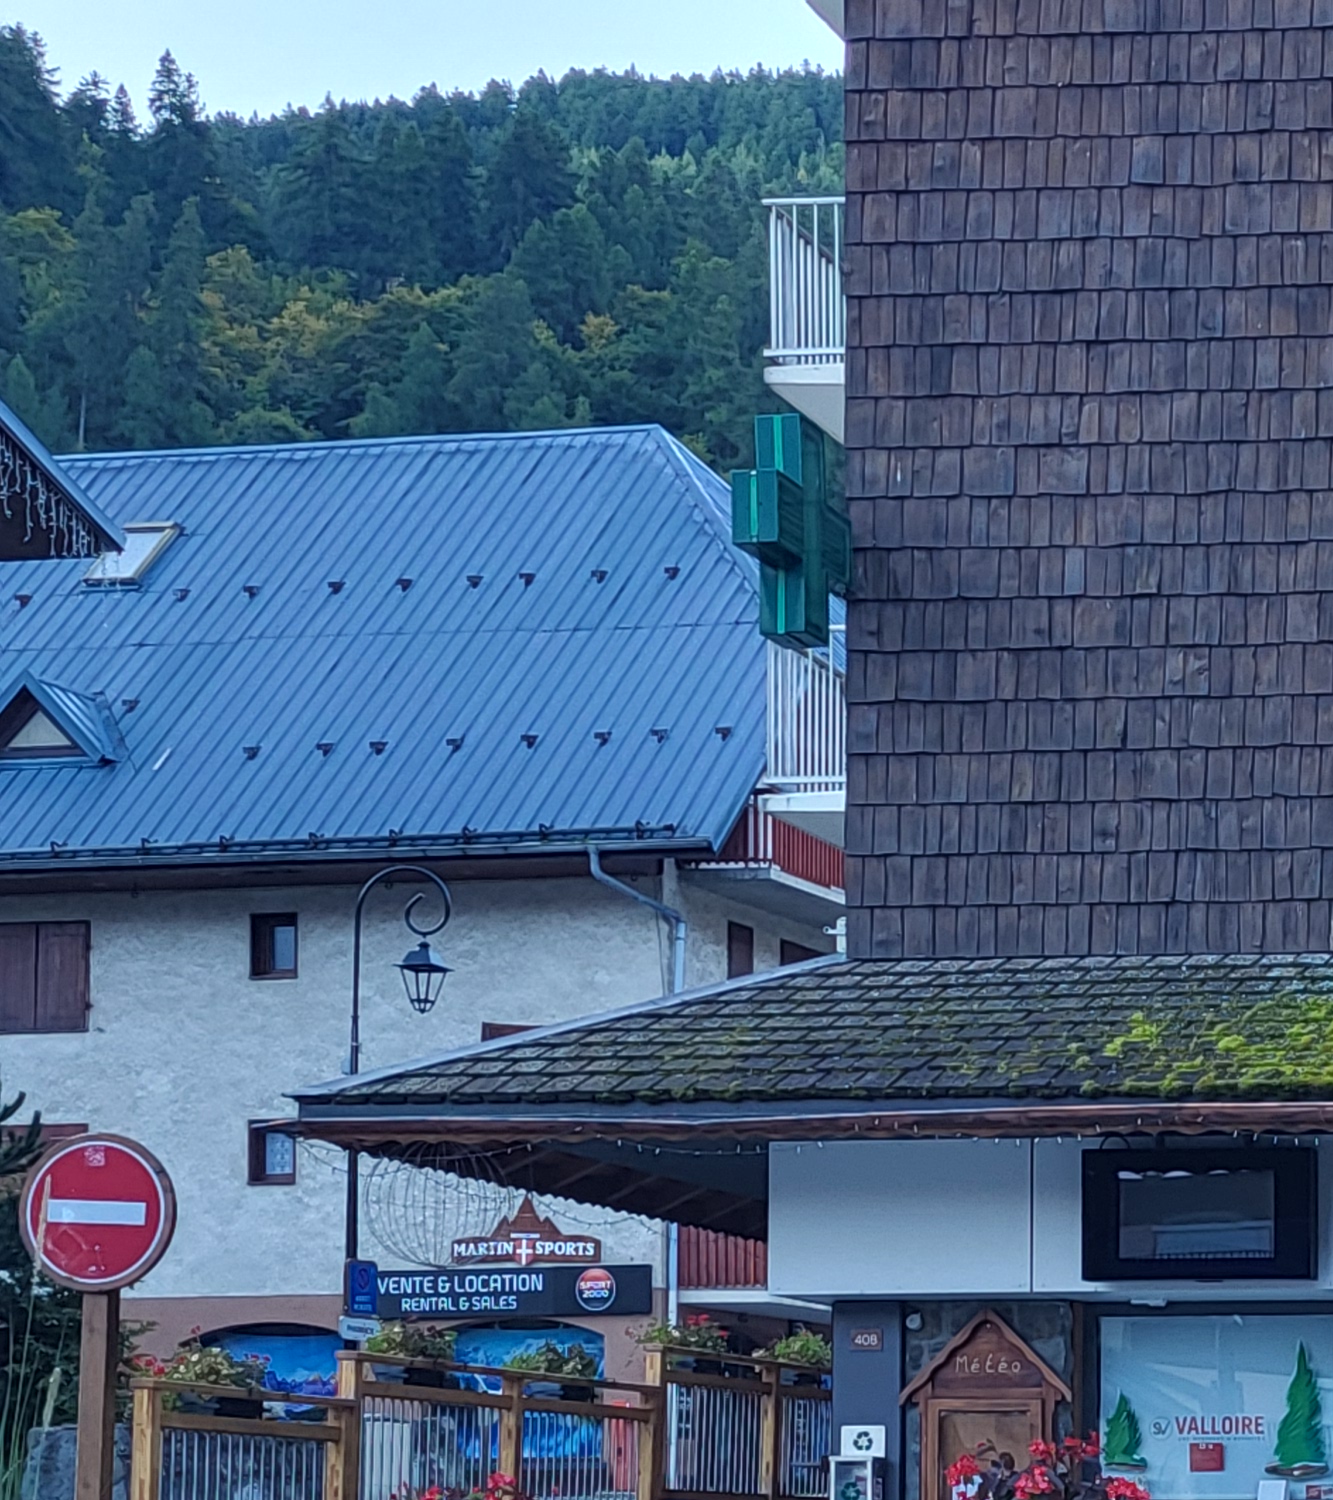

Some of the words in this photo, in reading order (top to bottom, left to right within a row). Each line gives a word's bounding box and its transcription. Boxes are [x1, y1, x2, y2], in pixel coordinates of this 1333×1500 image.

[453, 1241, 514, 1257] MARTIN
[535, 1241, 595, 1256] SPORTS
[377, 1277, 435, 1294] VENTE
[438, 1276, 451, 1293] &
[454, 1273, 543, 1292] LOCATION
[401, 1297, 457, 1312] RENTAL
[459, 1297, 469, 1310] &
[472, 1296, 517, 1310] SALES
[955, 1353, 1021, 1373] Météo
[1175, 1416, 1265, 1435] VALLOIRE
